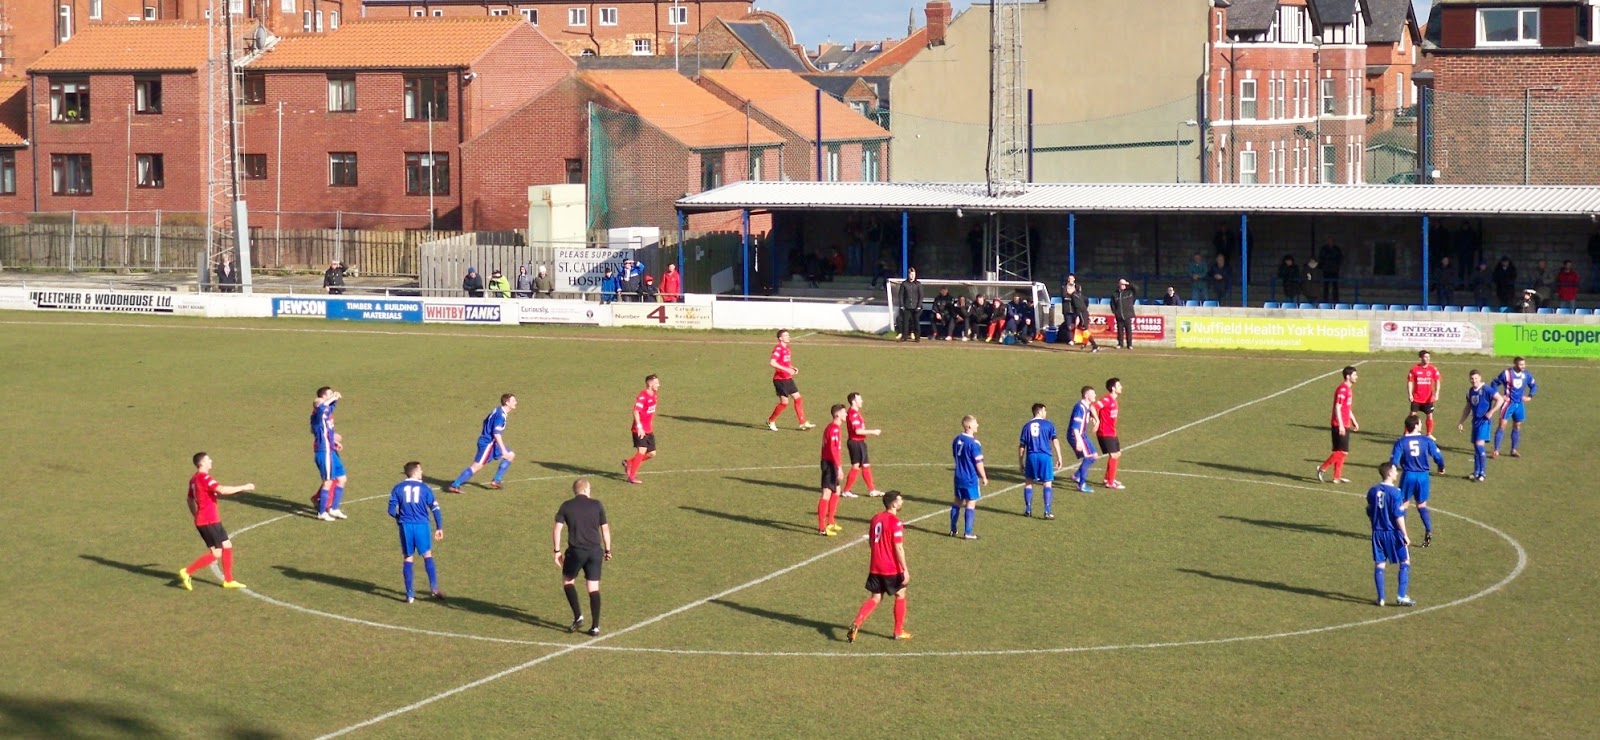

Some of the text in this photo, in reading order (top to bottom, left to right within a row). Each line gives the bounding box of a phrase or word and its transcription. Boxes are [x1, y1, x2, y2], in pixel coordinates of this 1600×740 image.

[559, 250, 629, 259] PLEASE SUPPORT
[558, 261, 621, 274] ST. CATHERIN
[568, 275, 602, 286] HOSP
[38, 291, 82, 305] FLETCHER
[85, 293, 91, 305] &
[95, 293, 154, 307] WOODHOUSE
[157, 295, 174, 308] Ltd.
[346, 302, 419, 312] TIMBER & BUILDING
[277, 300, 327, 315] JEWSON
[426, 306, 500, 320] WHITBY TANKS
[646, 305, 669, 323] 4
[363, 312, 403, 320] MATERIALS
[1088, 316, 1107, 325] YR
[1194, 321, 1367, 341] Nuffield Health York Hospital
[1512, 325, 1538, 342] The
[1030, 422, 1040, 437] 6
[1409, 440, 1420, 457] 5
[403, 484, 420, 504] 11
[874, 521, 882, 543] 9
